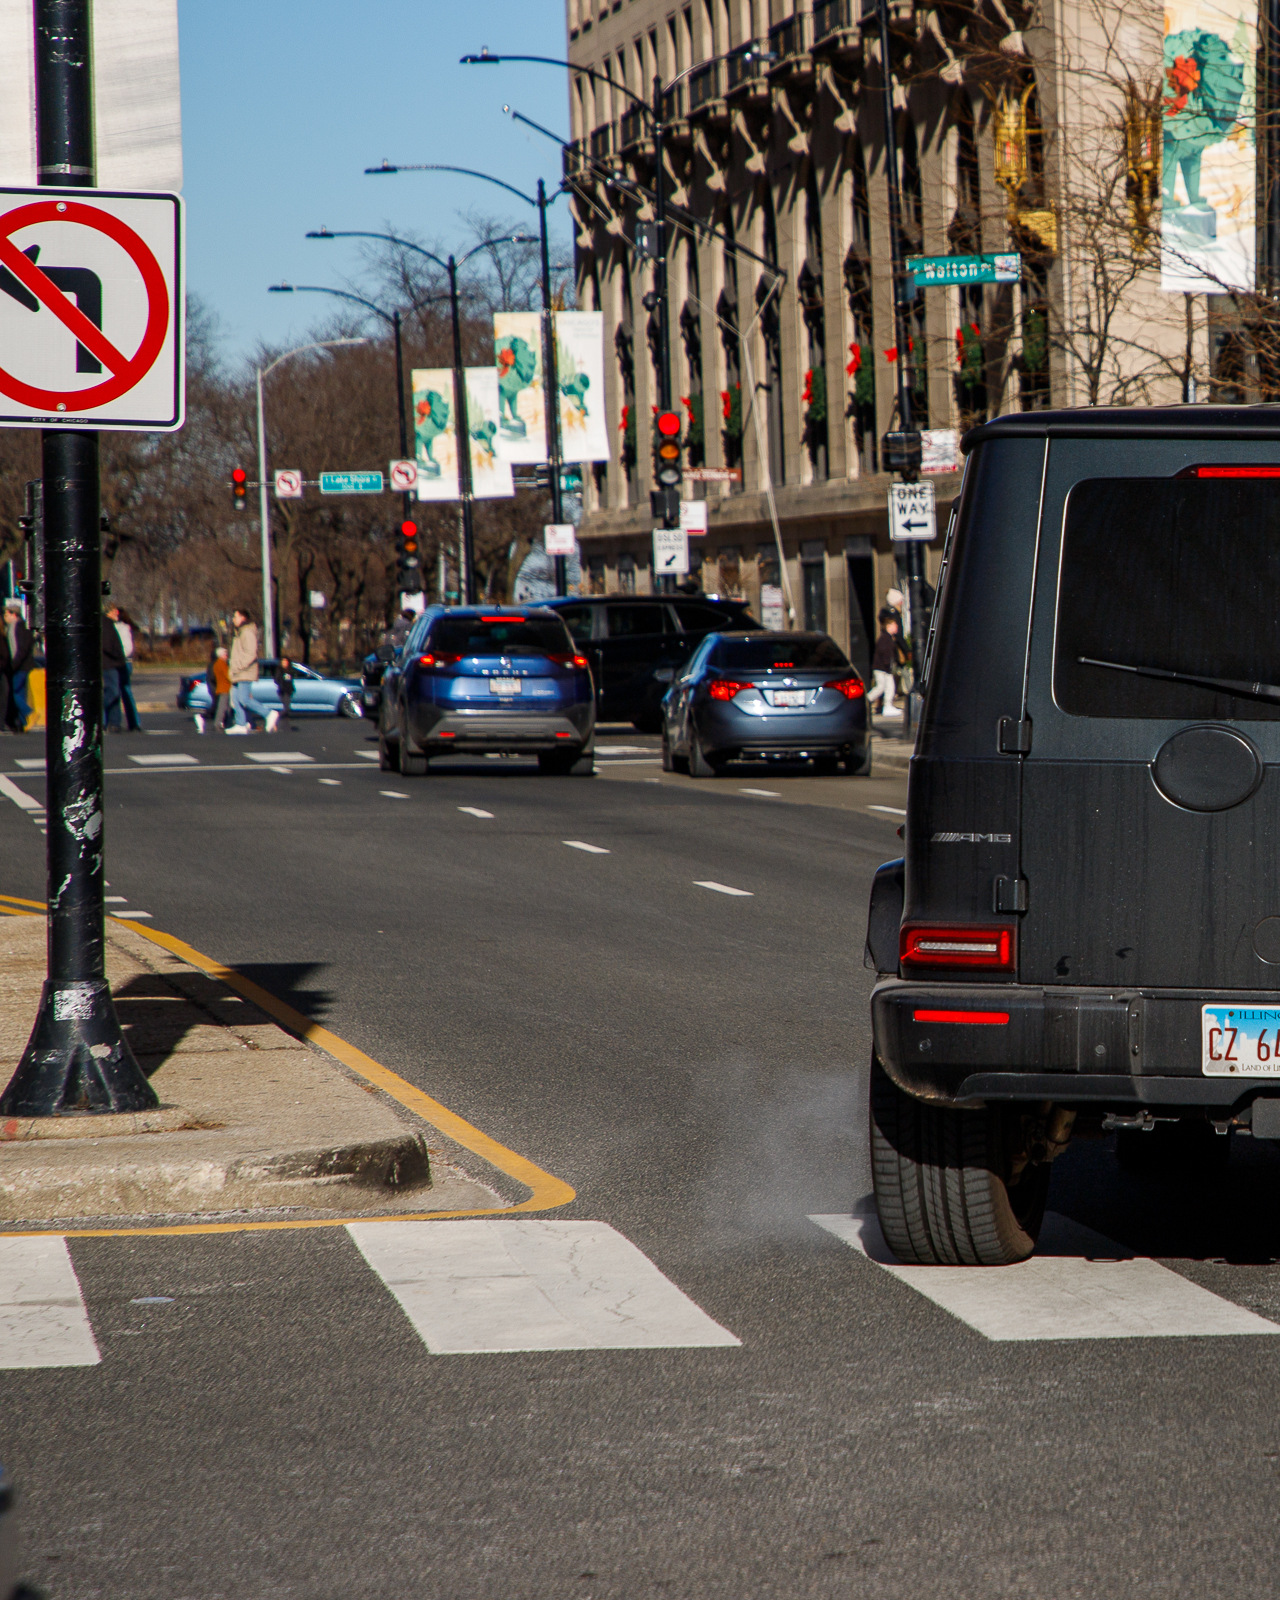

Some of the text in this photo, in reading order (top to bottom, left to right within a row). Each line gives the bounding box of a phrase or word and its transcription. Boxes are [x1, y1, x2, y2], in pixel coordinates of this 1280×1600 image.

[924, 262, 978, 279] Walton
[897, 486, 927, 499] ONE
[897, 502, 928, 515] WAY
[1209, 1028, 1238, 1061] CZ
